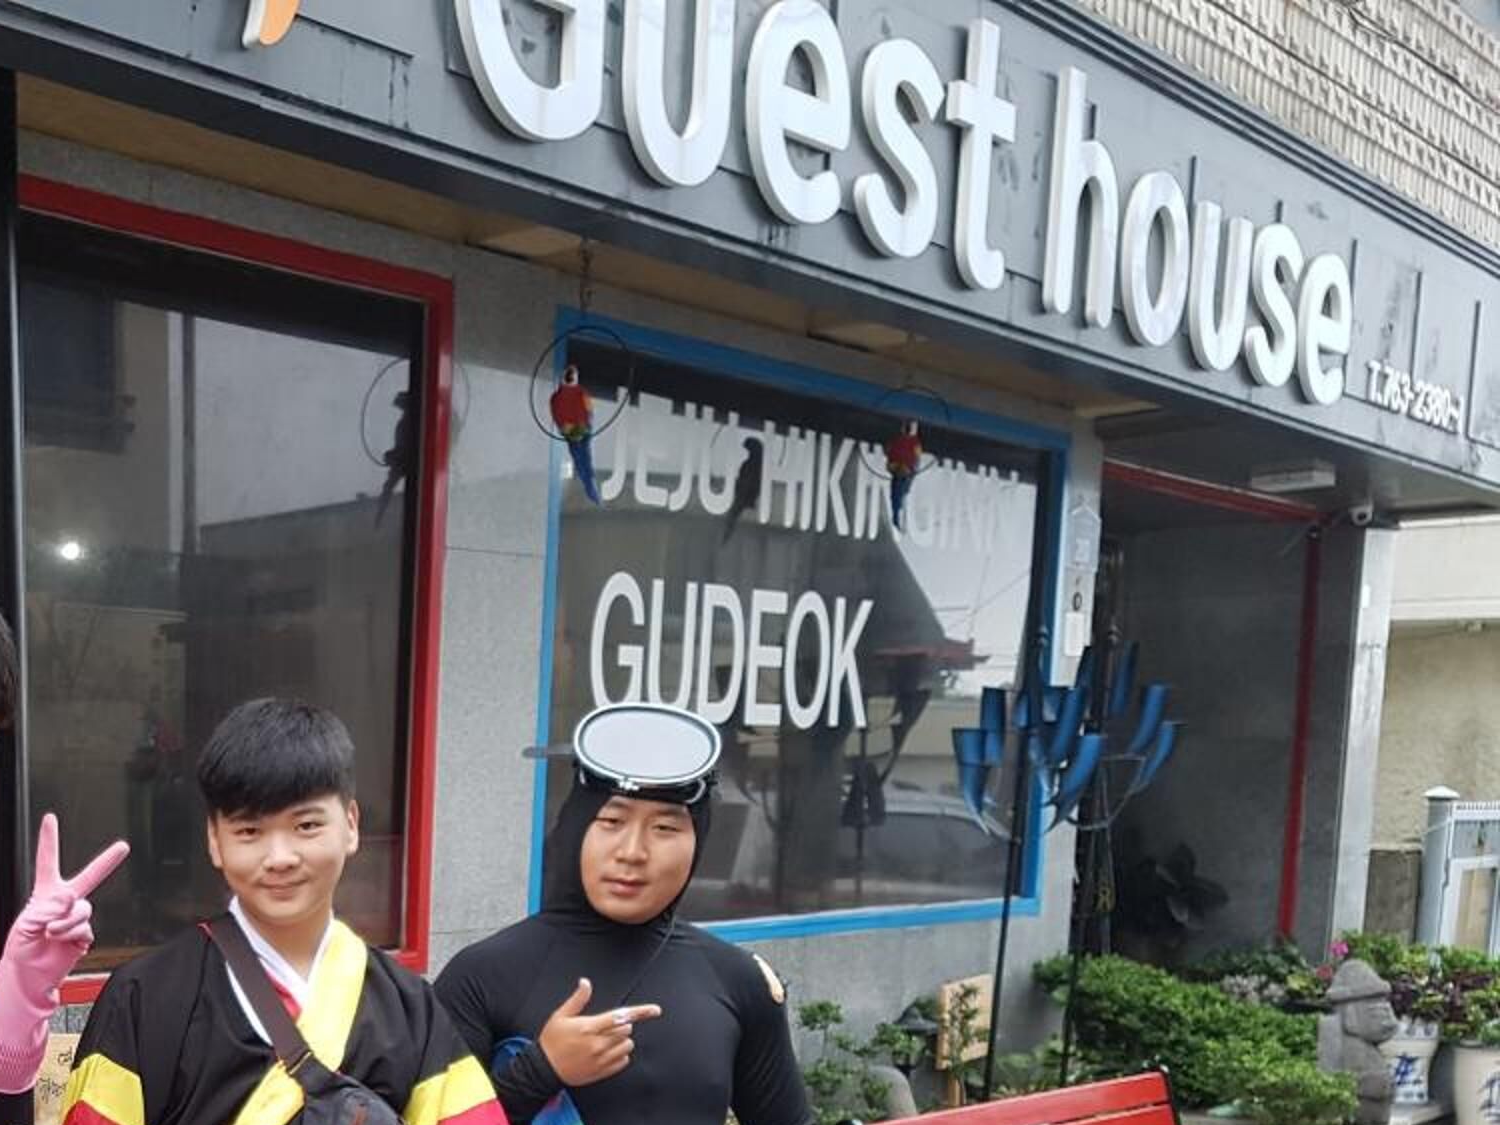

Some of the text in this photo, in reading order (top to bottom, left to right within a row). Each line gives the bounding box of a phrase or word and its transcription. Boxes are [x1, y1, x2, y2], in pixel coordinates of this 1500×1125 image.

[1042, 66, 1353, 406] house
[600, 386, 740, 516] JEJU
[590, 571, 874, 731] GUDEOK
